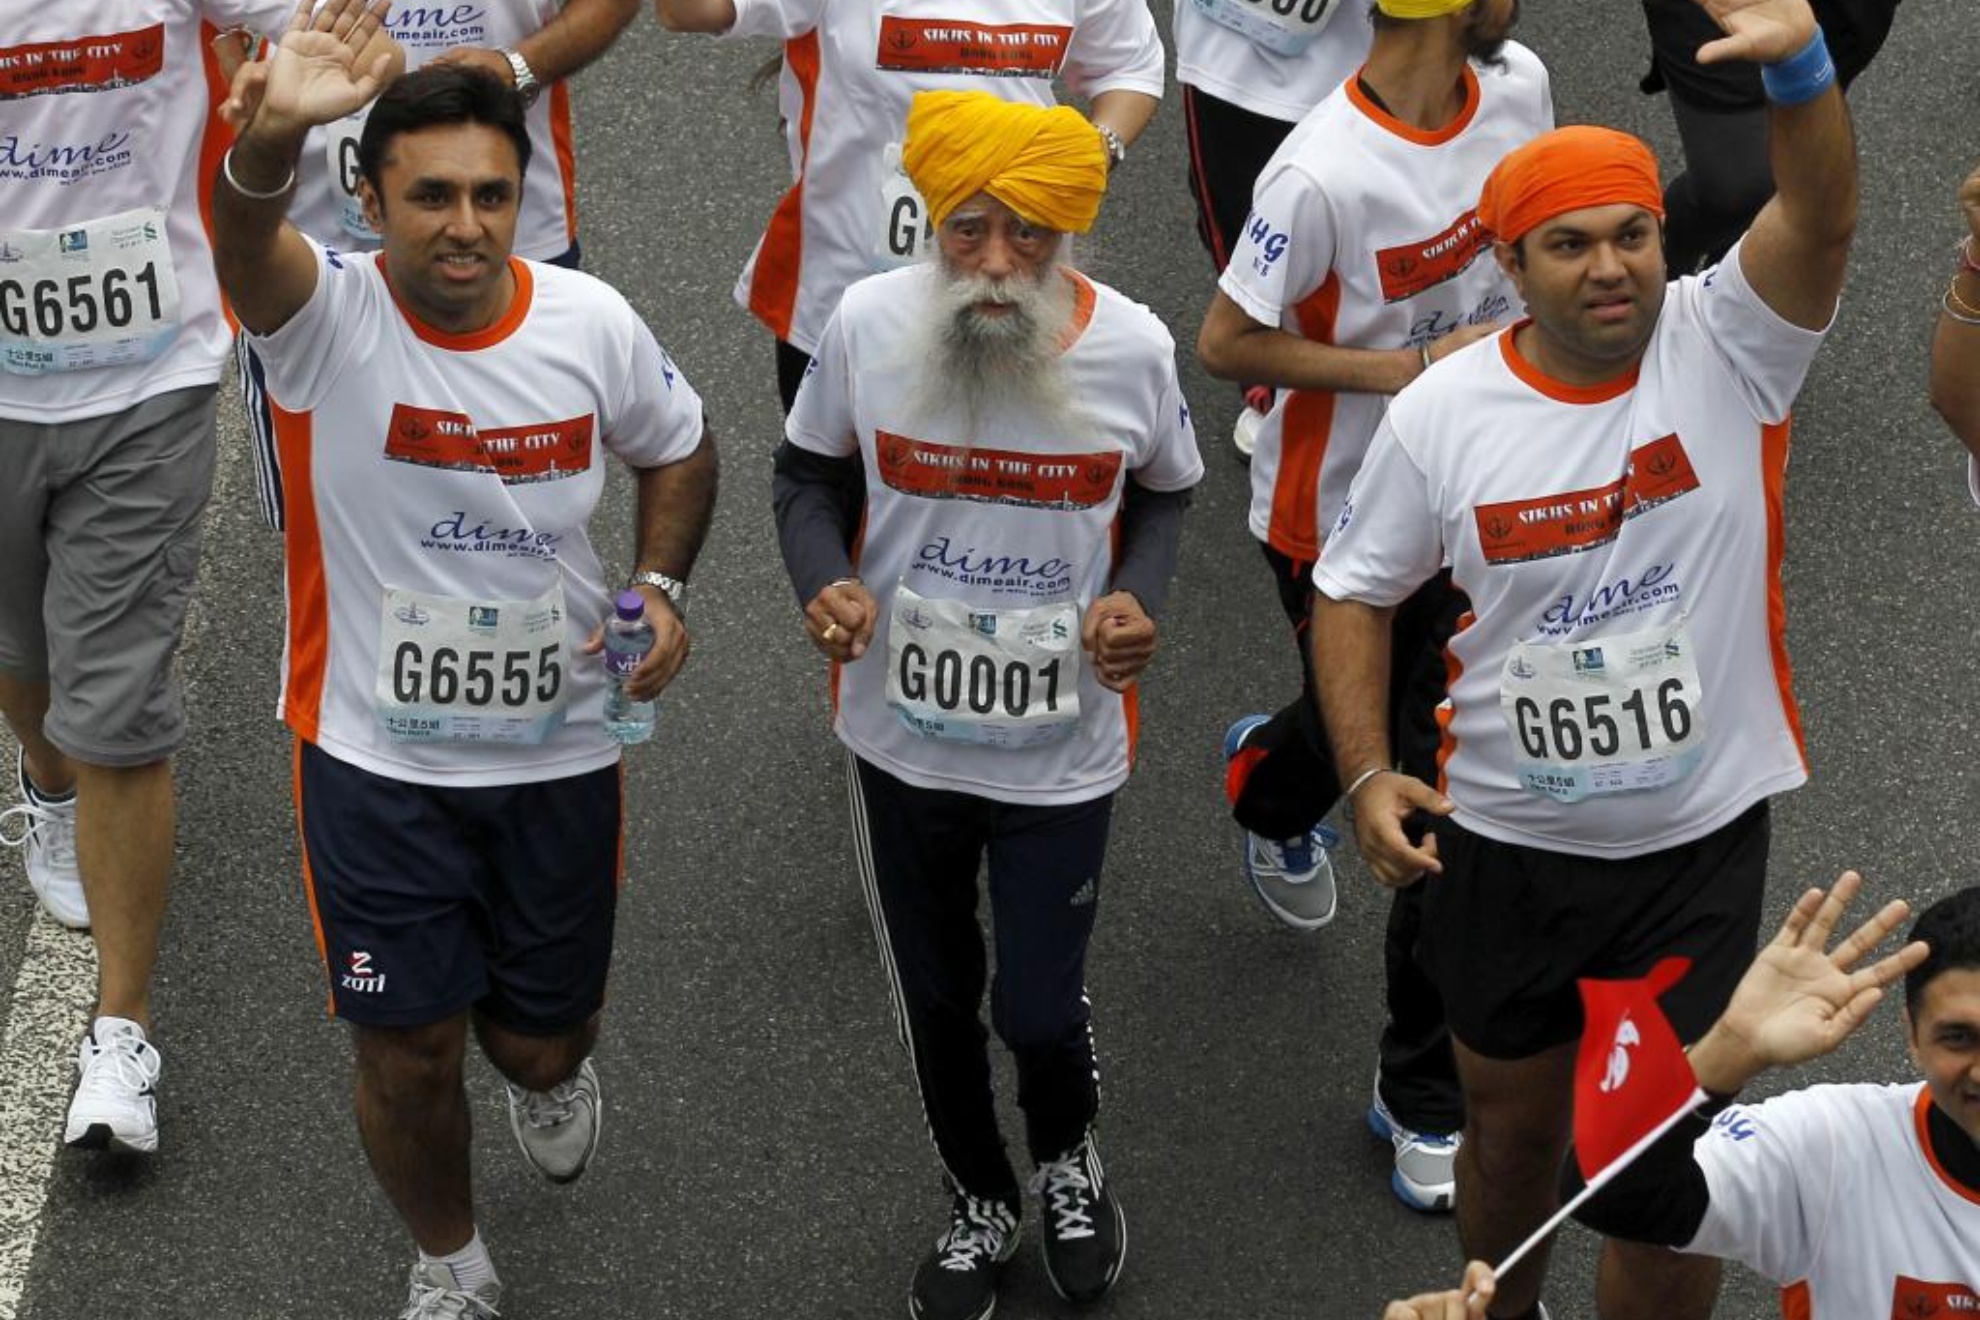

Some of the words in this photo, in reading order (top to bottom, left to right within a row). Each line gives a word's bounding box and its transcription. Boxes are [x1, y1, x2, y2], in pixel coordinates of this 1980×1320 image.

[923, 27, 972, 43] SIKHS
[977, 29, 993, 44] IN
[997, 31, 1030, 46] THE
[25, 51, 43, 66] IN
[48, 47, 81, 61] THE
[0, 261, 162, 338] G6561
[524, 431, 561, 450] CITY
[913, 450, 966, 469] SIKHS
[971, 456, 990, 471] IN
[995, 458, 1032, 475] THE
[1037, 464, 1078, 479] CITY
[1518, 502, 1574, 524] SIKHS
[1579, 498, 1598, 515] IN
[919, 536, 1073, 578] dime
[912, 562, 1071, 590] www.dimeair.com
[393, 640, 562, 707] G6555
[900, 642, 1061, 718] G0001
[1515, 677, 1692, 761] G6516
